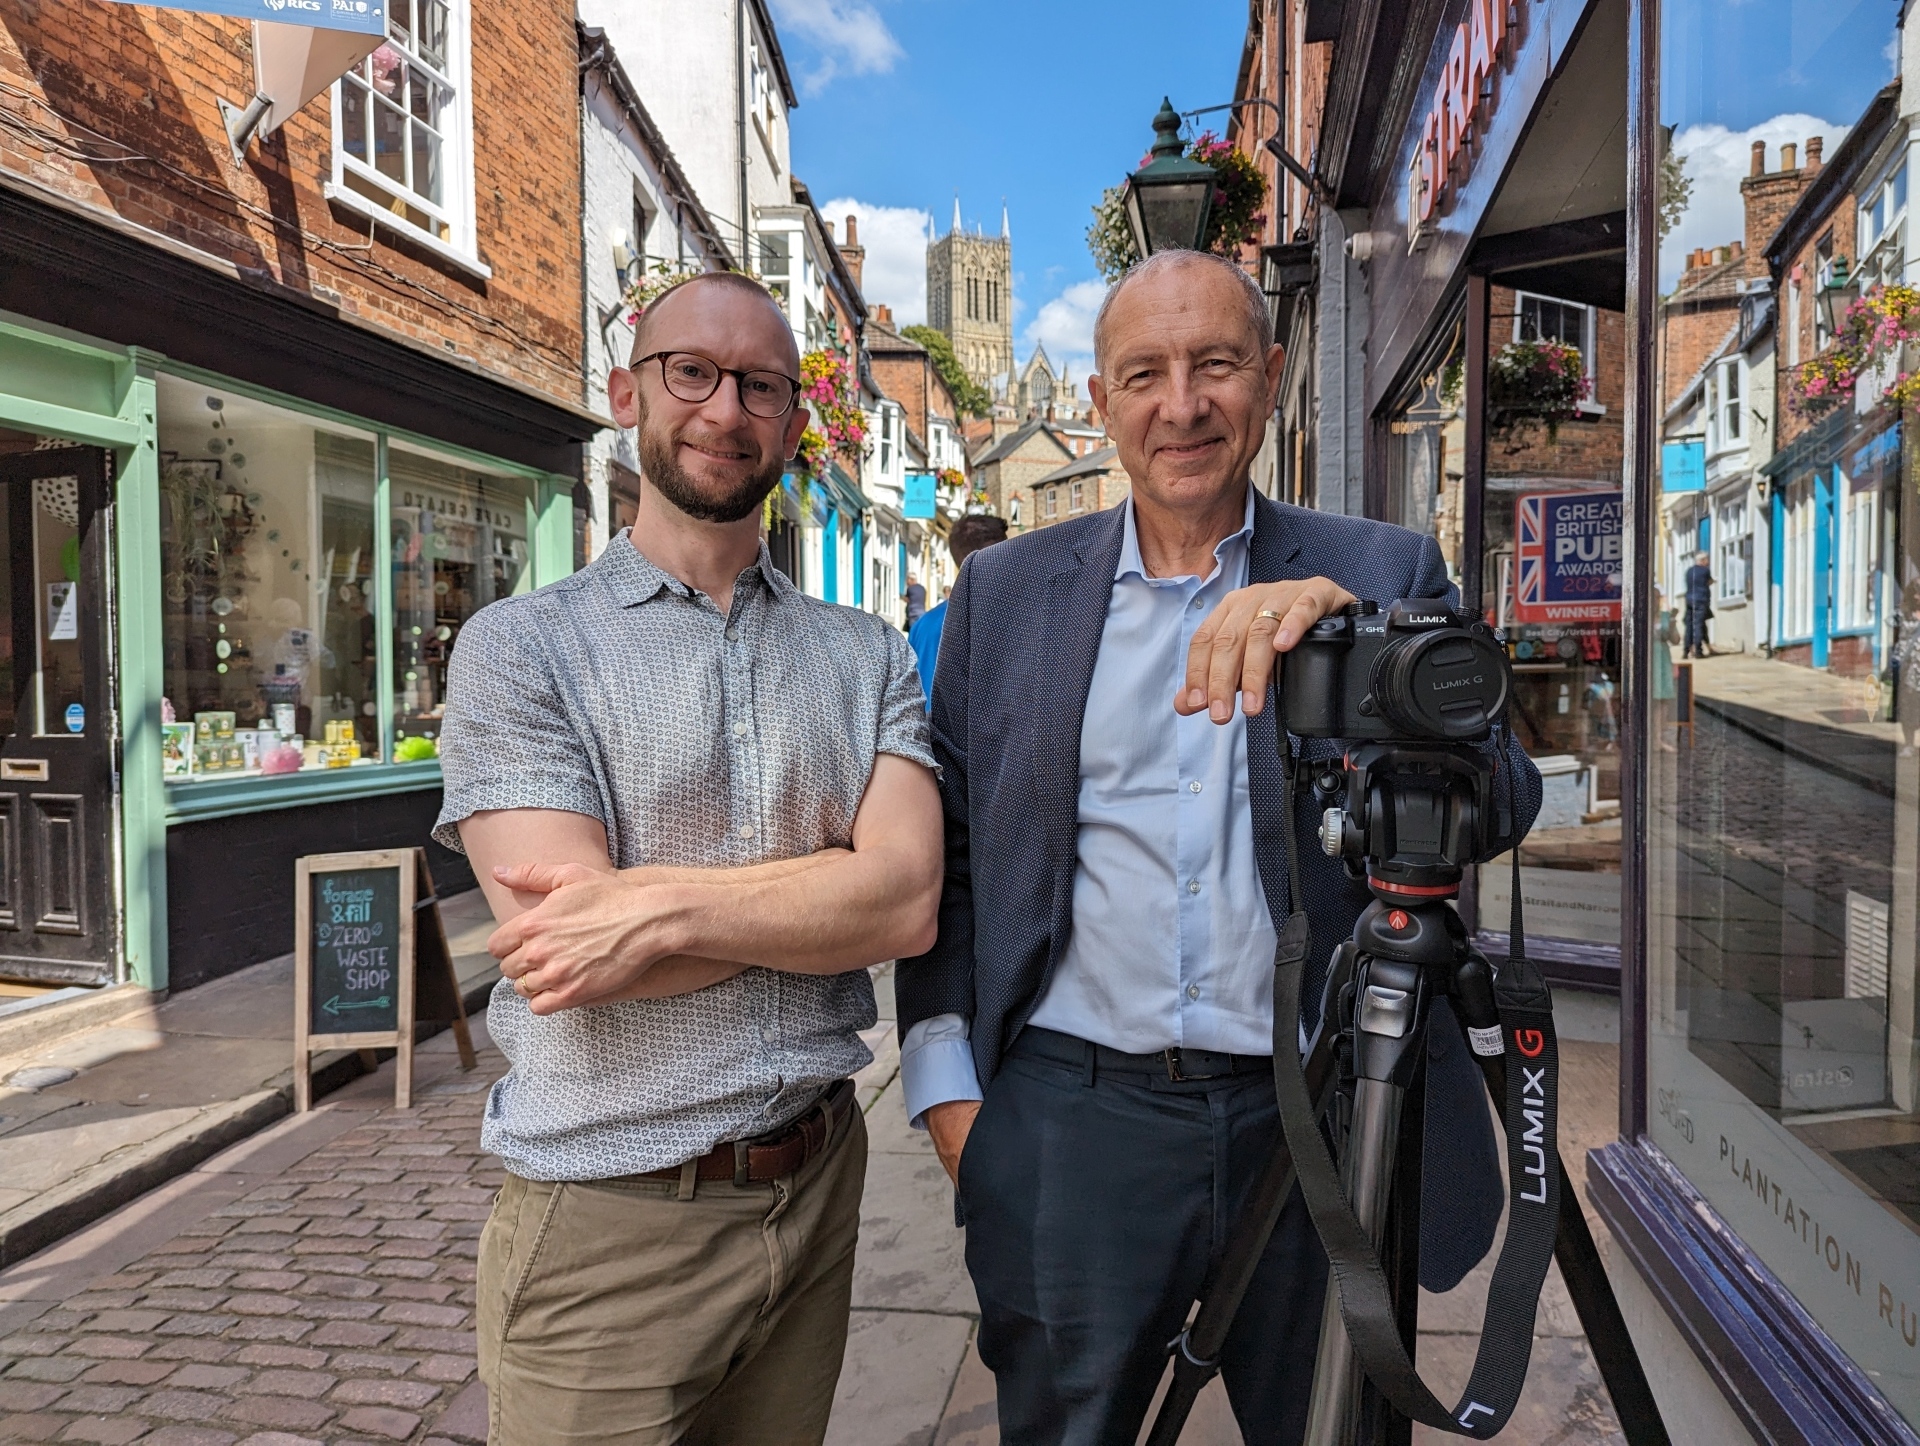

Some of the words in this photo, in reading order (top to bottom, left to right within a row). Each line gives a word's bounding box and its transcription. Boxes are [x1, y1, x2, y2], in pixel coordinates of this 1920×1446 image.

[287, 0, 321, 11] RICS
[332, 0, 354, 12] PAI
[1556, 502, 1623, 522] GREAT
[1555, 520, 1623, 537] BRITISH
[1555, 534, 1623, 563] PUB
[1409, 614, 1448, 624] LUMIX
[1546, 606, 1610, 619] WINNER
[1526, 629, 1545, 637] Best
[1600, 629, 1615, 637] Bar
[1433, 678, 1471, 691] LUMIX
[1473, 675, 1484, 684] G
[332, 925, 372, 947] ZERO
[336, 946, 389, 967] WASTE
[345, 968, 391, 990] SHOP
[1515, 1029, 1545, 1058] G
[1520, 1066, 1547, 1204] LUMIX
[1720, 1134, 1861, 1296] PLANTATION
